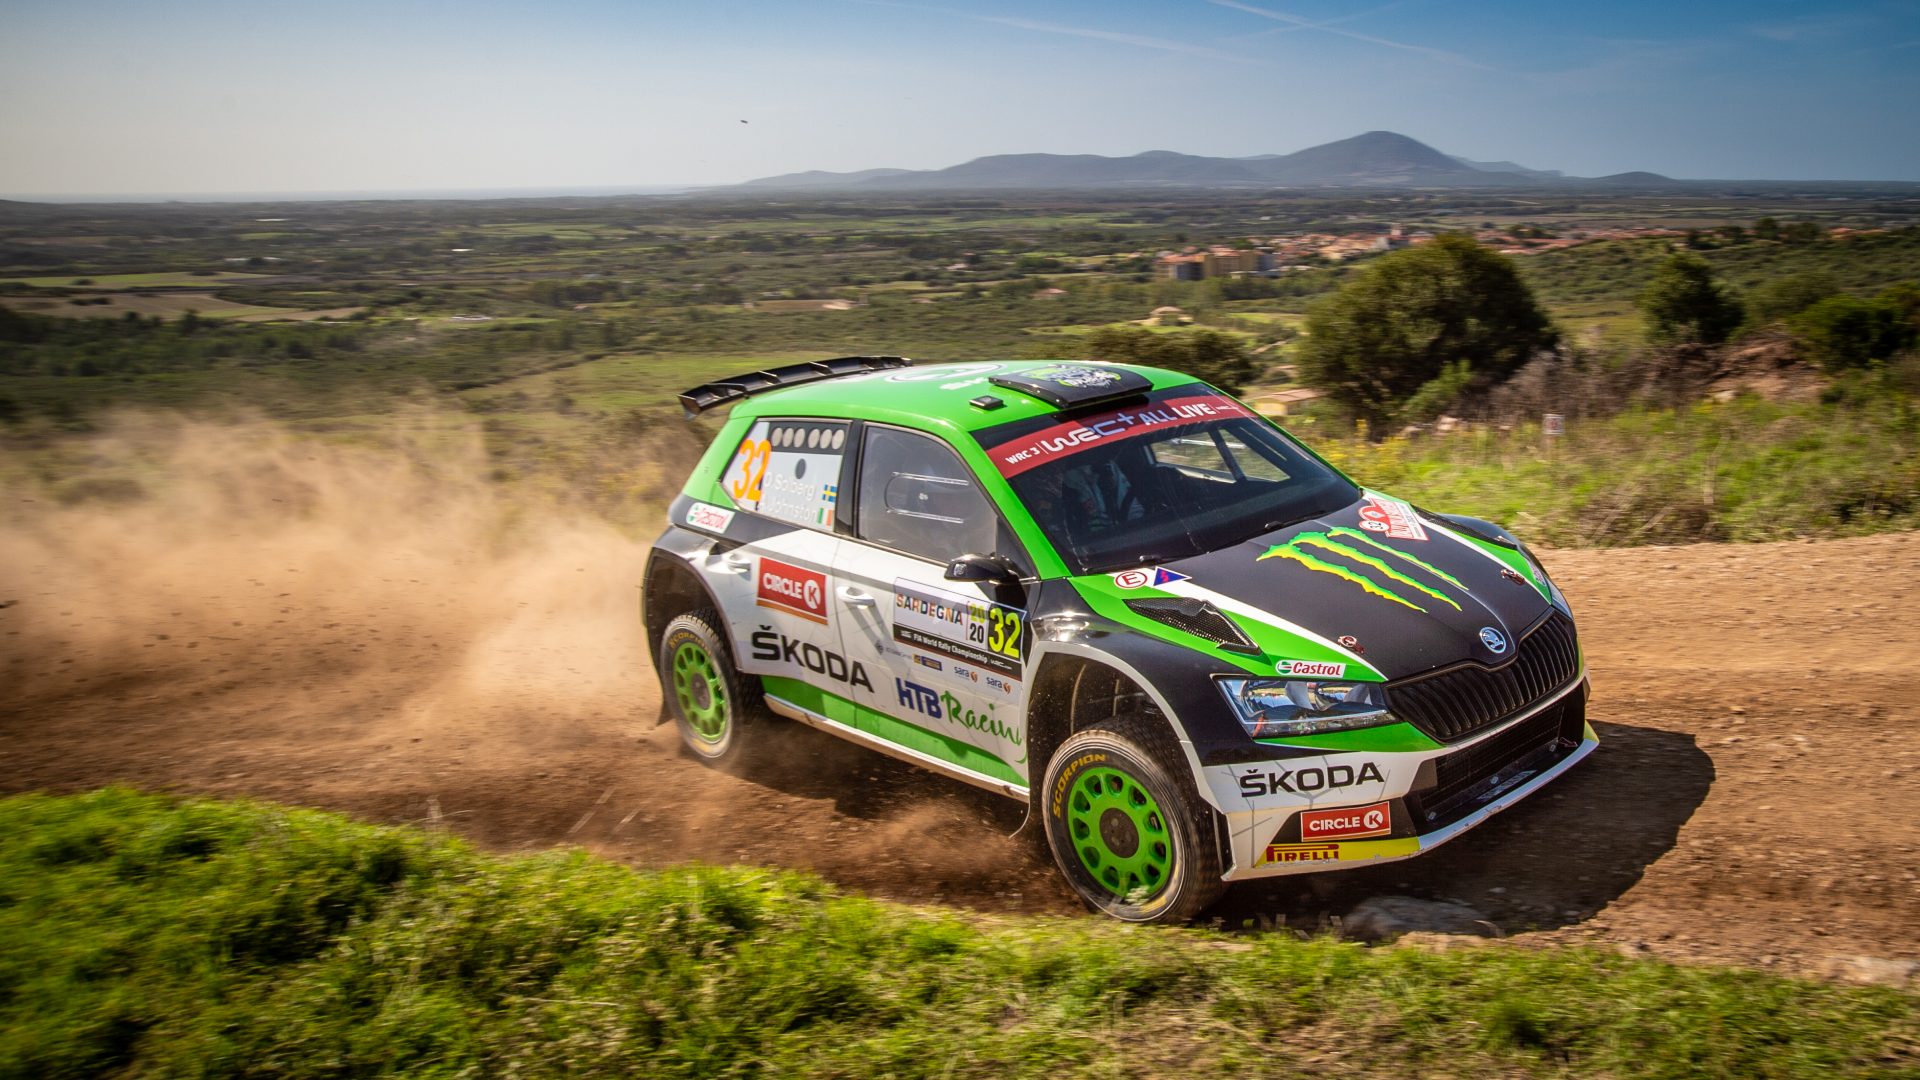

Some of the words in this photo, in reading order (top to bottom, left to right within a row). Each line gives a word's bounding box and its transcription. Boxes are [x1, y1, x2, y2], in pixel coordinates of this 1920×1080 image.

[1005, 449, 1032, 464] WRC
[1032, 447, 1040, 456] 3
[1140, 410, 1177, 426] ALL
[1173, 403, 1217, 418] LIVE
[733, 439, 772, 502] 32
[763, 572, 803, 600] CIRCLE
[896, 594, 963, 625] SARDEGNA
[969, 603, 986, 624] 20
[969, 622, 985, 644] 20
[988, 607, 1022, 659] 32
[752, 624, 875, 694] ŠKODA
[954, 667, 970, 678] sara
[1292, 661, 1342, 676] Castrol
[895, 677, 942, 719] HTB
[986, 677, 1003, 690] sara
[1053, 753, 1106, 819] SCORPION
[1239, 762, 1385, 798] ŠKODA
[1309, 816, 1361, 832] CIRCLE
[1265, 843, 1340, 863] PIRELLI
